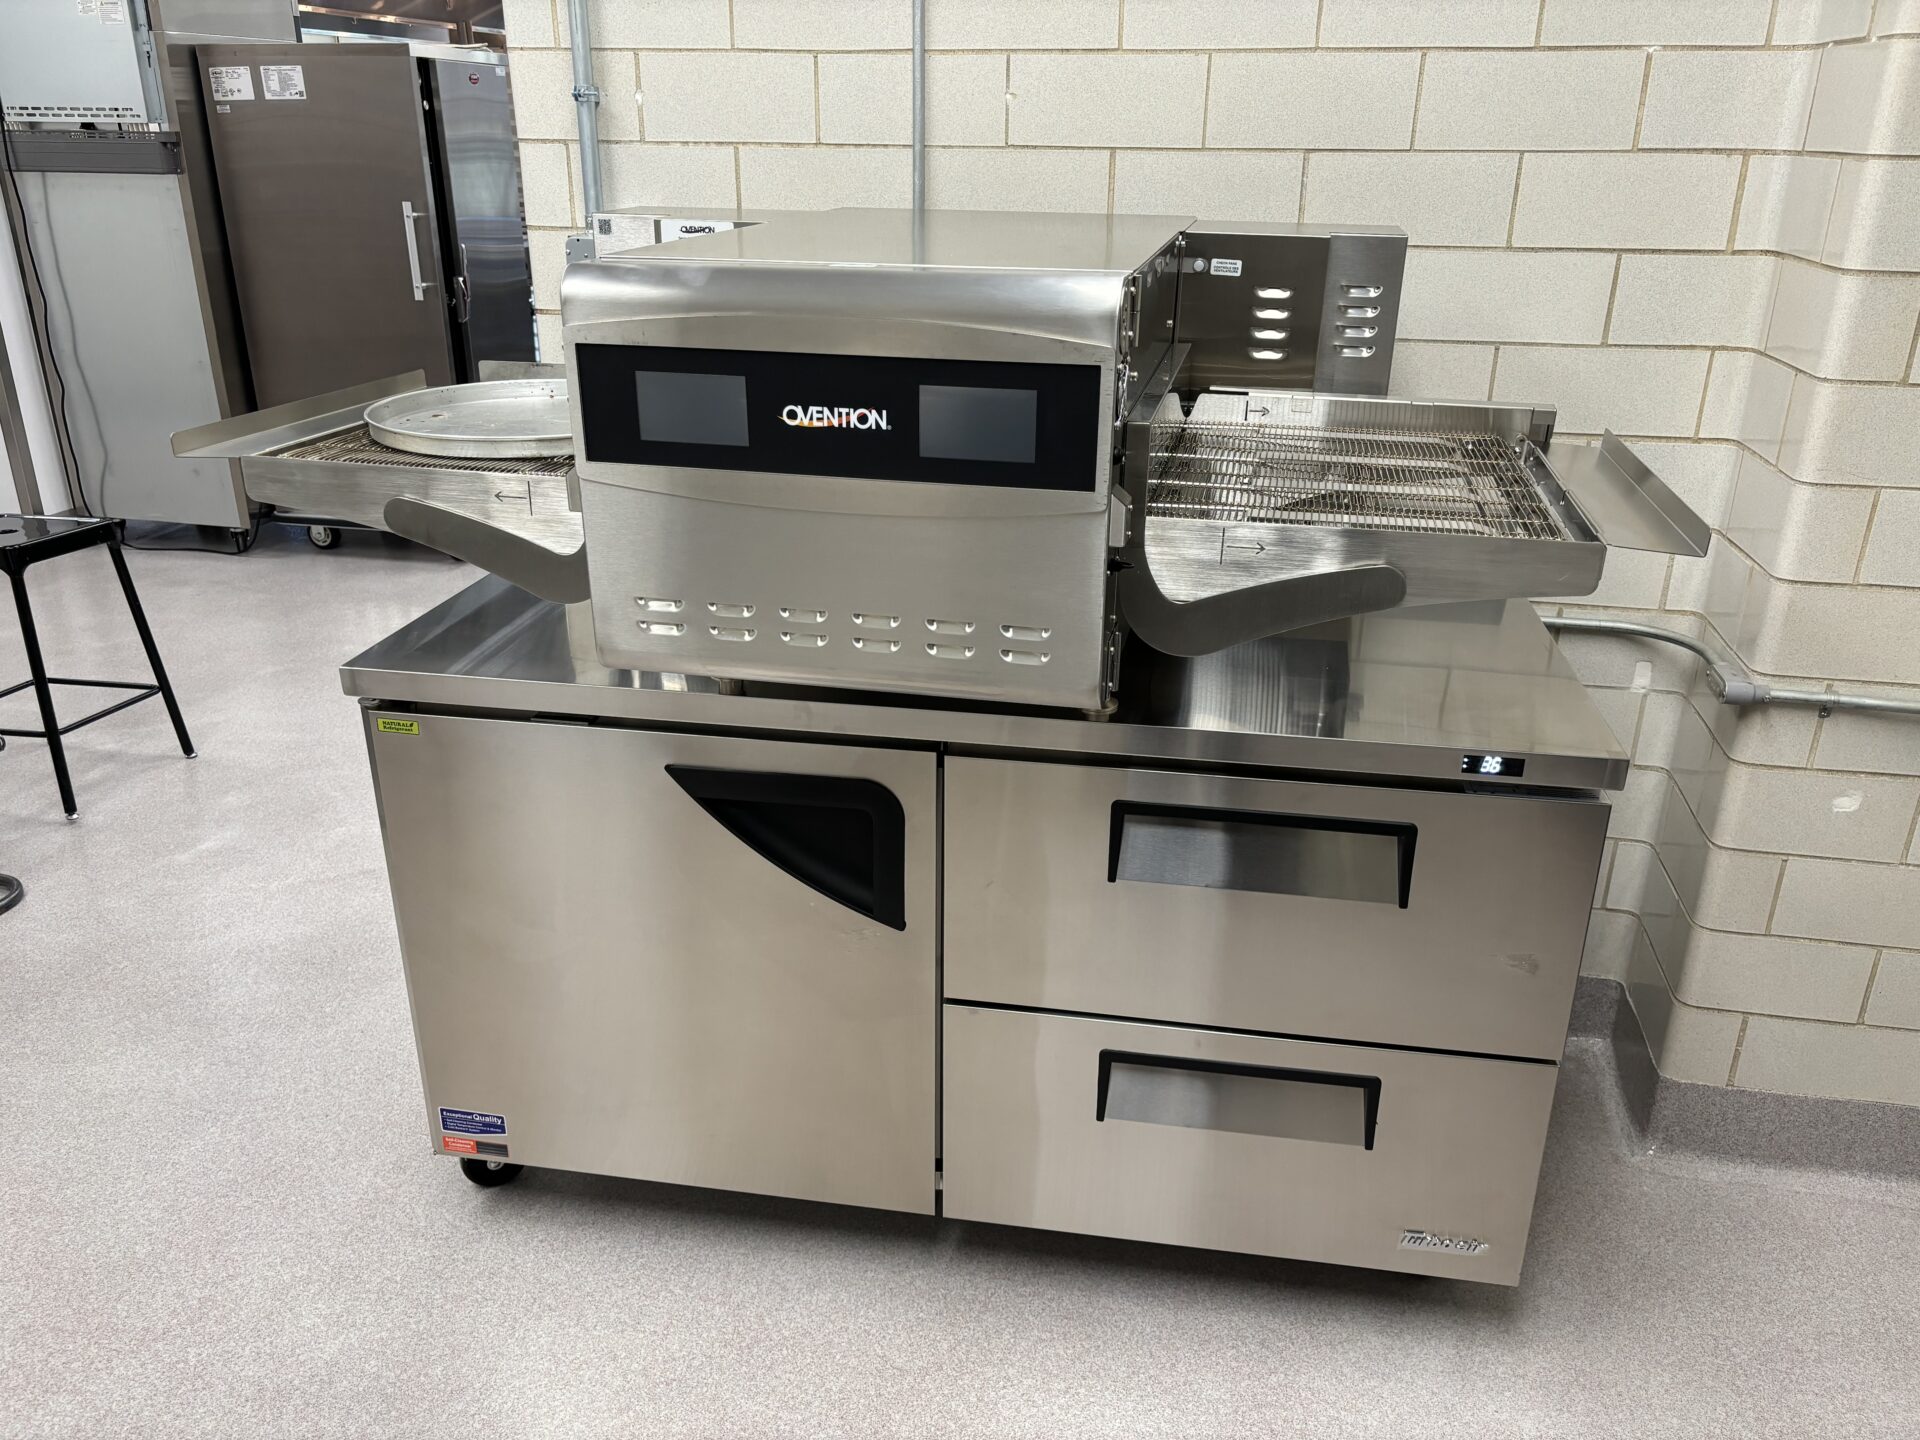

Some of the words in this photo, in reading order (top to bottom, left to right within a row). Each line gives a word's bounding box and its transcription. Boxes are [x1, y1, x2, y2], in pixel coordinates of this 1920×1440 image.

[680, 225, 715, 234] OVENTION
[782, 404, 887, 430] OVENTION
[443, 1111, 472, 1119] Exceptional
[473, 1113, 502, 1125] Quality
